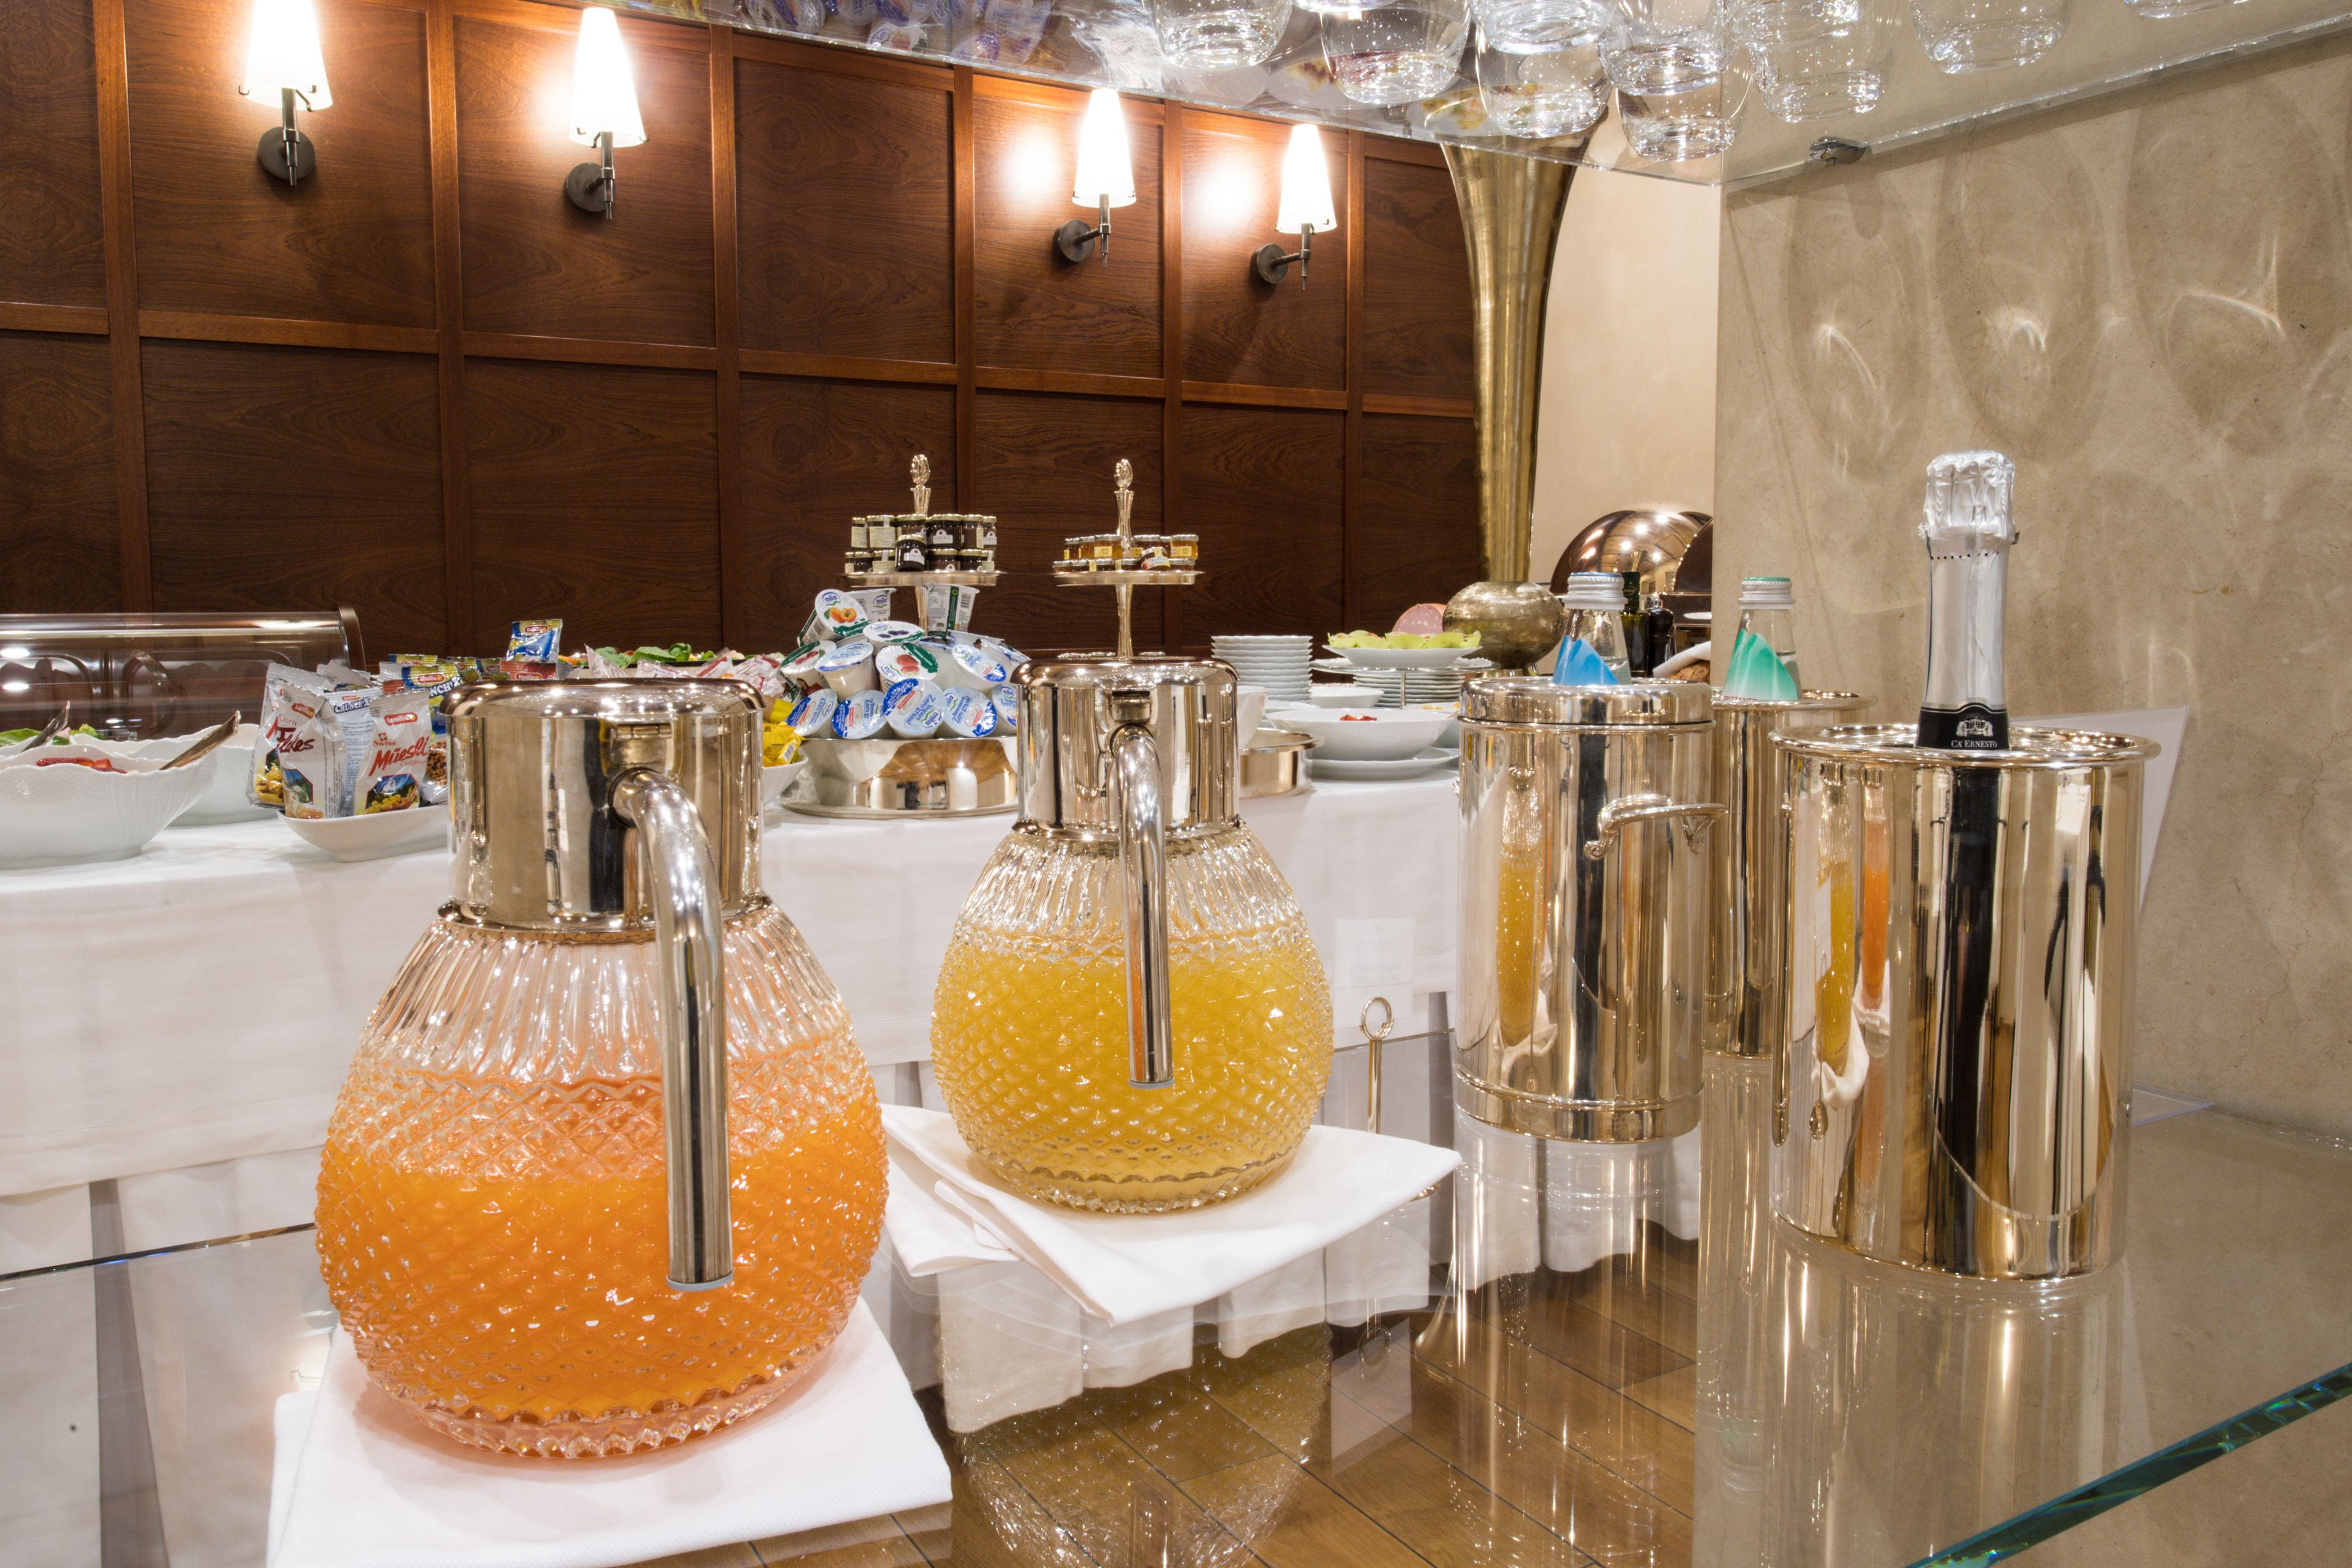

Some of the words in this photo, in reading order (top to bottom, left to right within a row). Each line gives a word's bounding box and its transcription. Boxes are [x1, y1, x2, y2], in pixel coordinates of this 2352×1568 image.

[430, 676, 464, 697] NCH'X
[920, 693, 936, 708] Zero
[279, 714, 297, 726] Corn
[905, 706, 921, 725] grassi
[915, 704, 933, 721] Yogurt
[925, 712, 938, 726] mila
[952, 711, 963, 724] Zero
[1964, 739, 1998, 748] ERNESTO
[368, 736, 430, 777] Müesli
